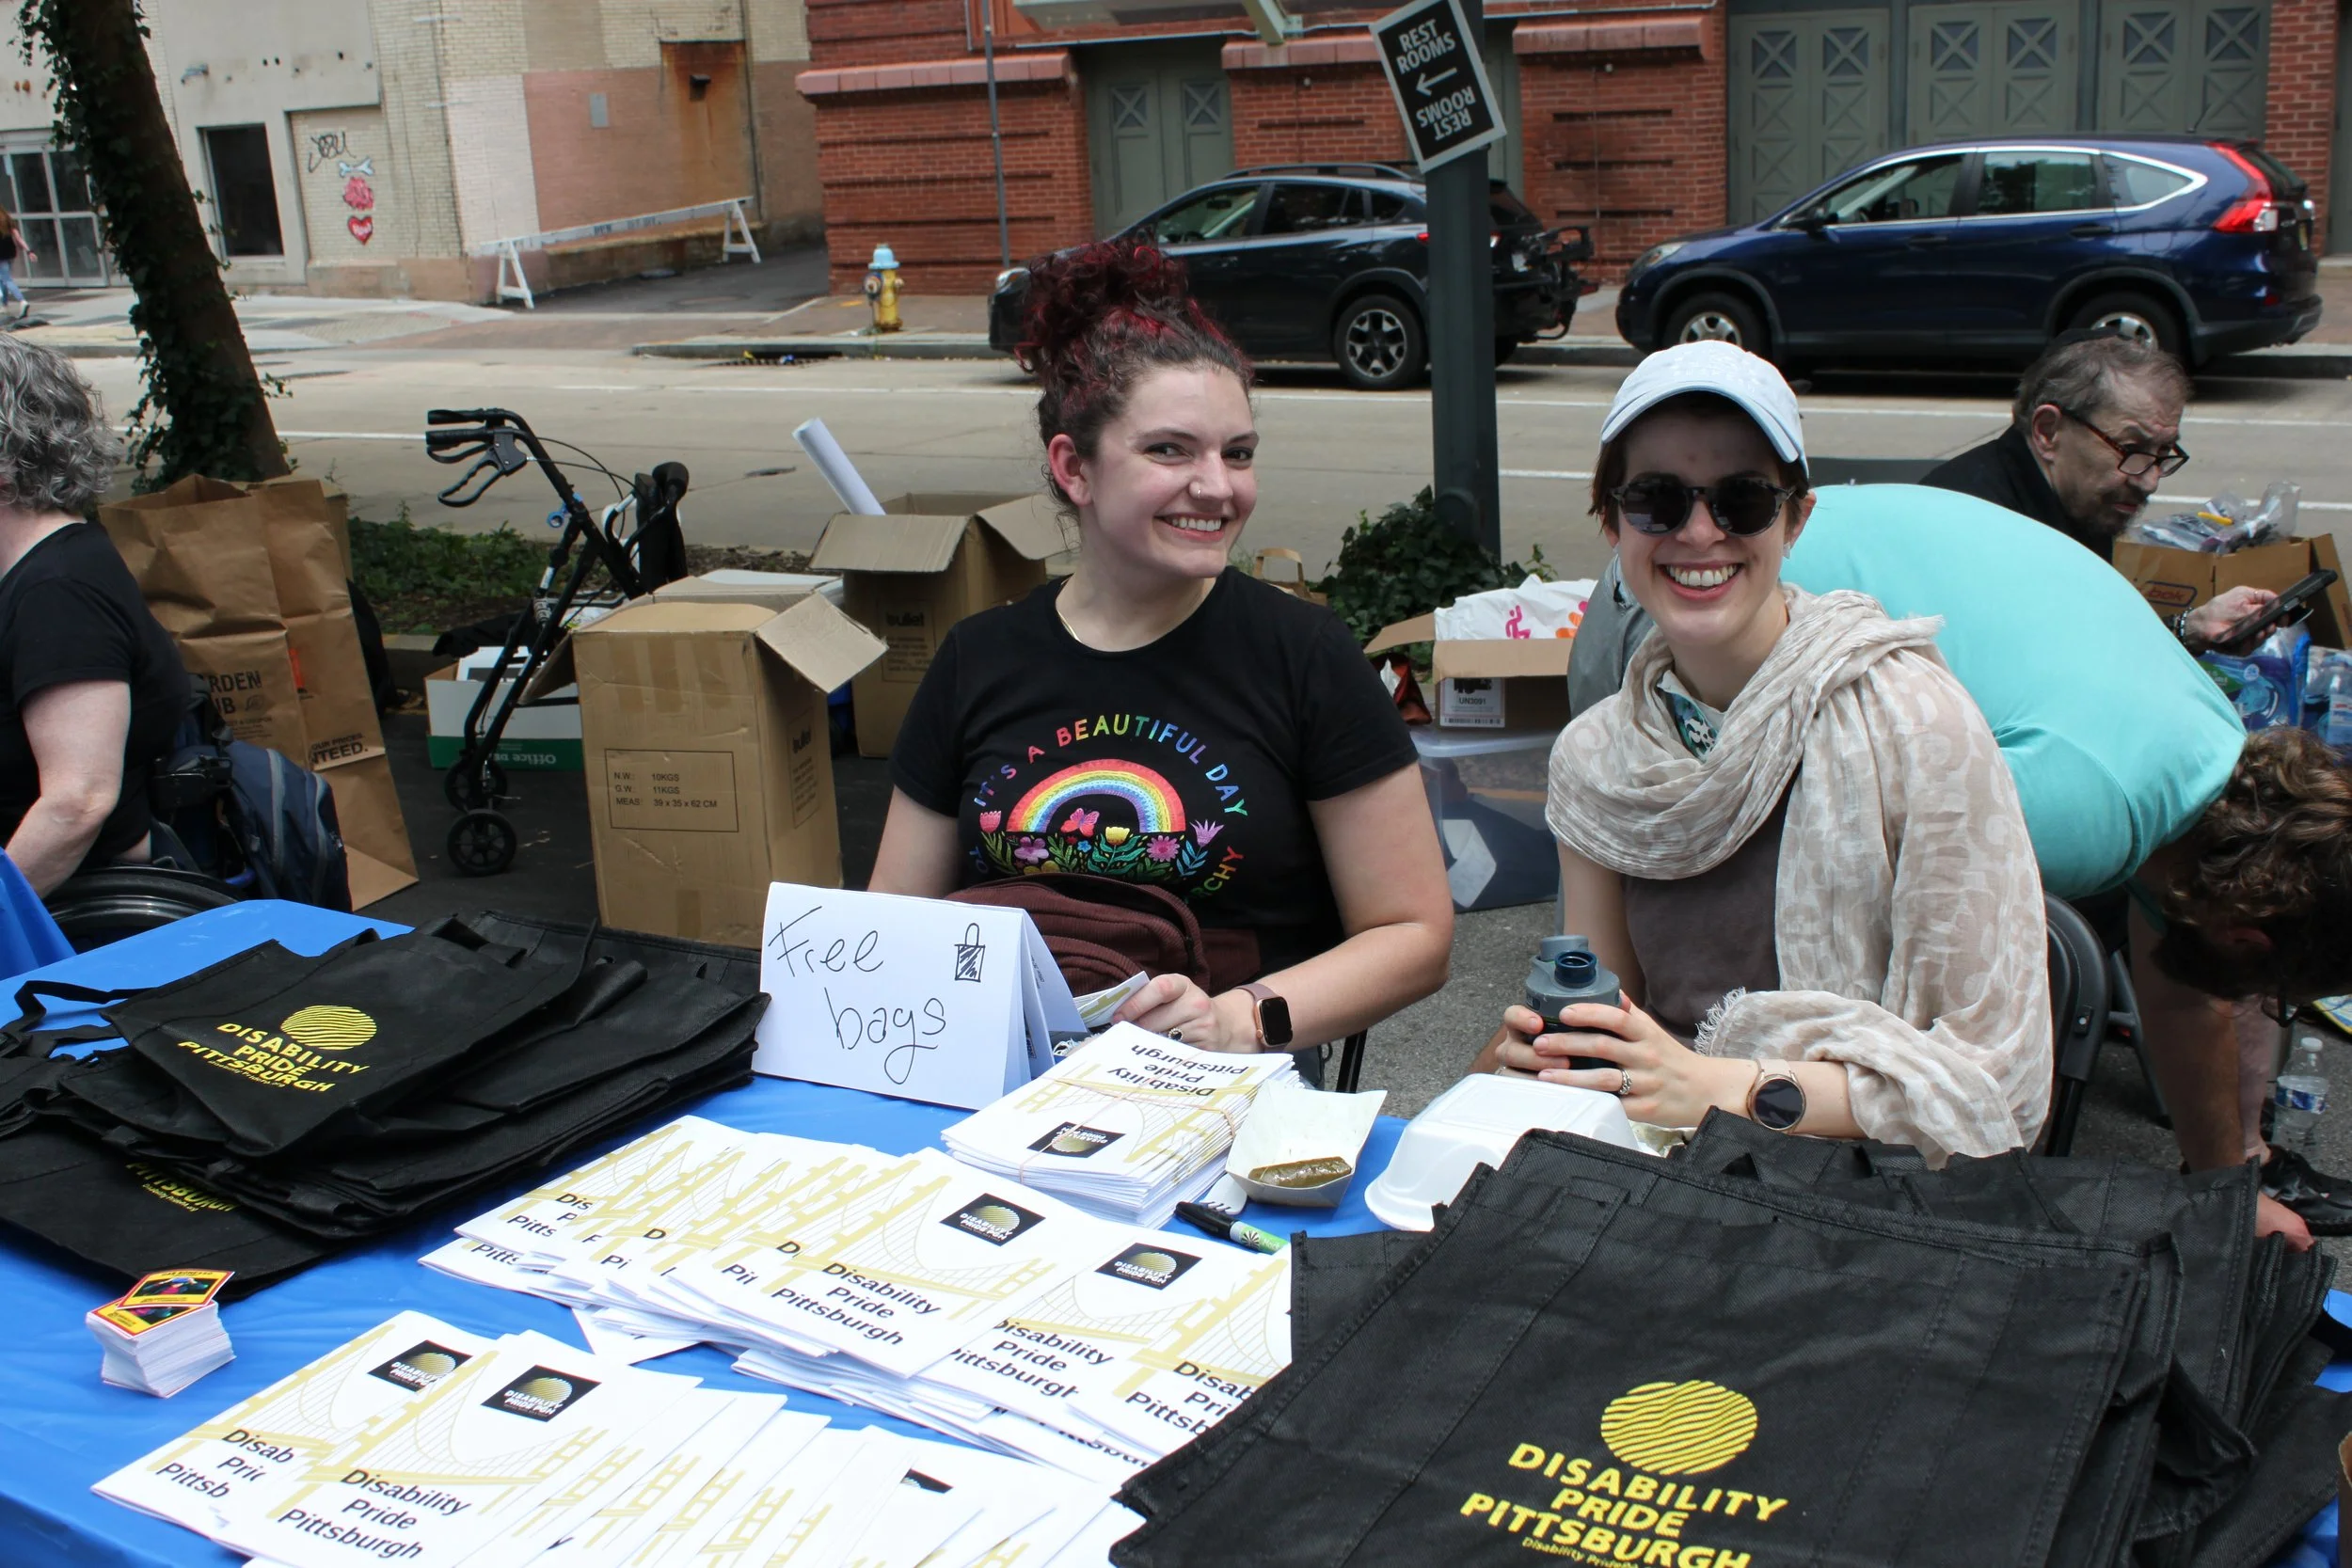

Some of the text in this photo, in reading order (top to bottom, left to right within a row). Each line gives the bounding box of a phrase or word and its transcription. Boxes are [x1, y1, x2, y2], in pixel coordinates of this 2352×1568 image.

[1399, 19, 1438, 52] REST
[1396, 32, 1456, 74] ROOMS
[1416, 86, 1476, 128] ROOMS
[1434, 107, 1472, 141] REST
[205, 670, 262, 693] RDEN
[652, 773, 679, 782] 10KGS
[974, 714, 1248, 816] IT'S A BEAUTIFUL DAY
[653, 786, 680, 795] 11KGS
[703, 800, 717, 808] CM
[768, 905, 883, 977] Free
[216, 1022, 371, 1074] DISABILITY
[824, 987, 946, 1085] bags
[178, 1041, 336, 1092] PITTSBURGH
[232, 1044, 312, 1077] PRIDE
[1132, 1045, 1249, 1074] Pittsburgh
[1144, 1064, 1205, 1083] Pride
[1106, 1067, 1216, 1097] Disability
[960, 1212, 1013, 1236] DISABILITY
[960, 1219, 988, 1233] PRIDE
[1114, 1260, 1172, 1279] DISABILITY
[1116, 1267, 1144, 1278] PRIDE
[821, 1262, 942, 1315] Disability
[826, 1286, 895, 1318] Pride
[771, 1288, 904, 1345] Pittsburgh
[993, 1340, 1068, 1371] Pride
[503, 1389, 564, 1409] DISABILITY
[221, 1429, 294, 1465] Disab
[155, 1463, 230, 1498] Pittsb
[340, 1468, 473, 1517] Disability
[1508, 1442, 1788, 1523] DISABILITY
[341, 1497, 418, 1531] Pride
[1460, 1492, 1752, 1568] PITTSBURGH
[1550, 1487, 1690, 1540] PRIDE
[282, 1507, 424, 1560] Pittsburgh
[1521, 1536, 1586, 1562] Disability
